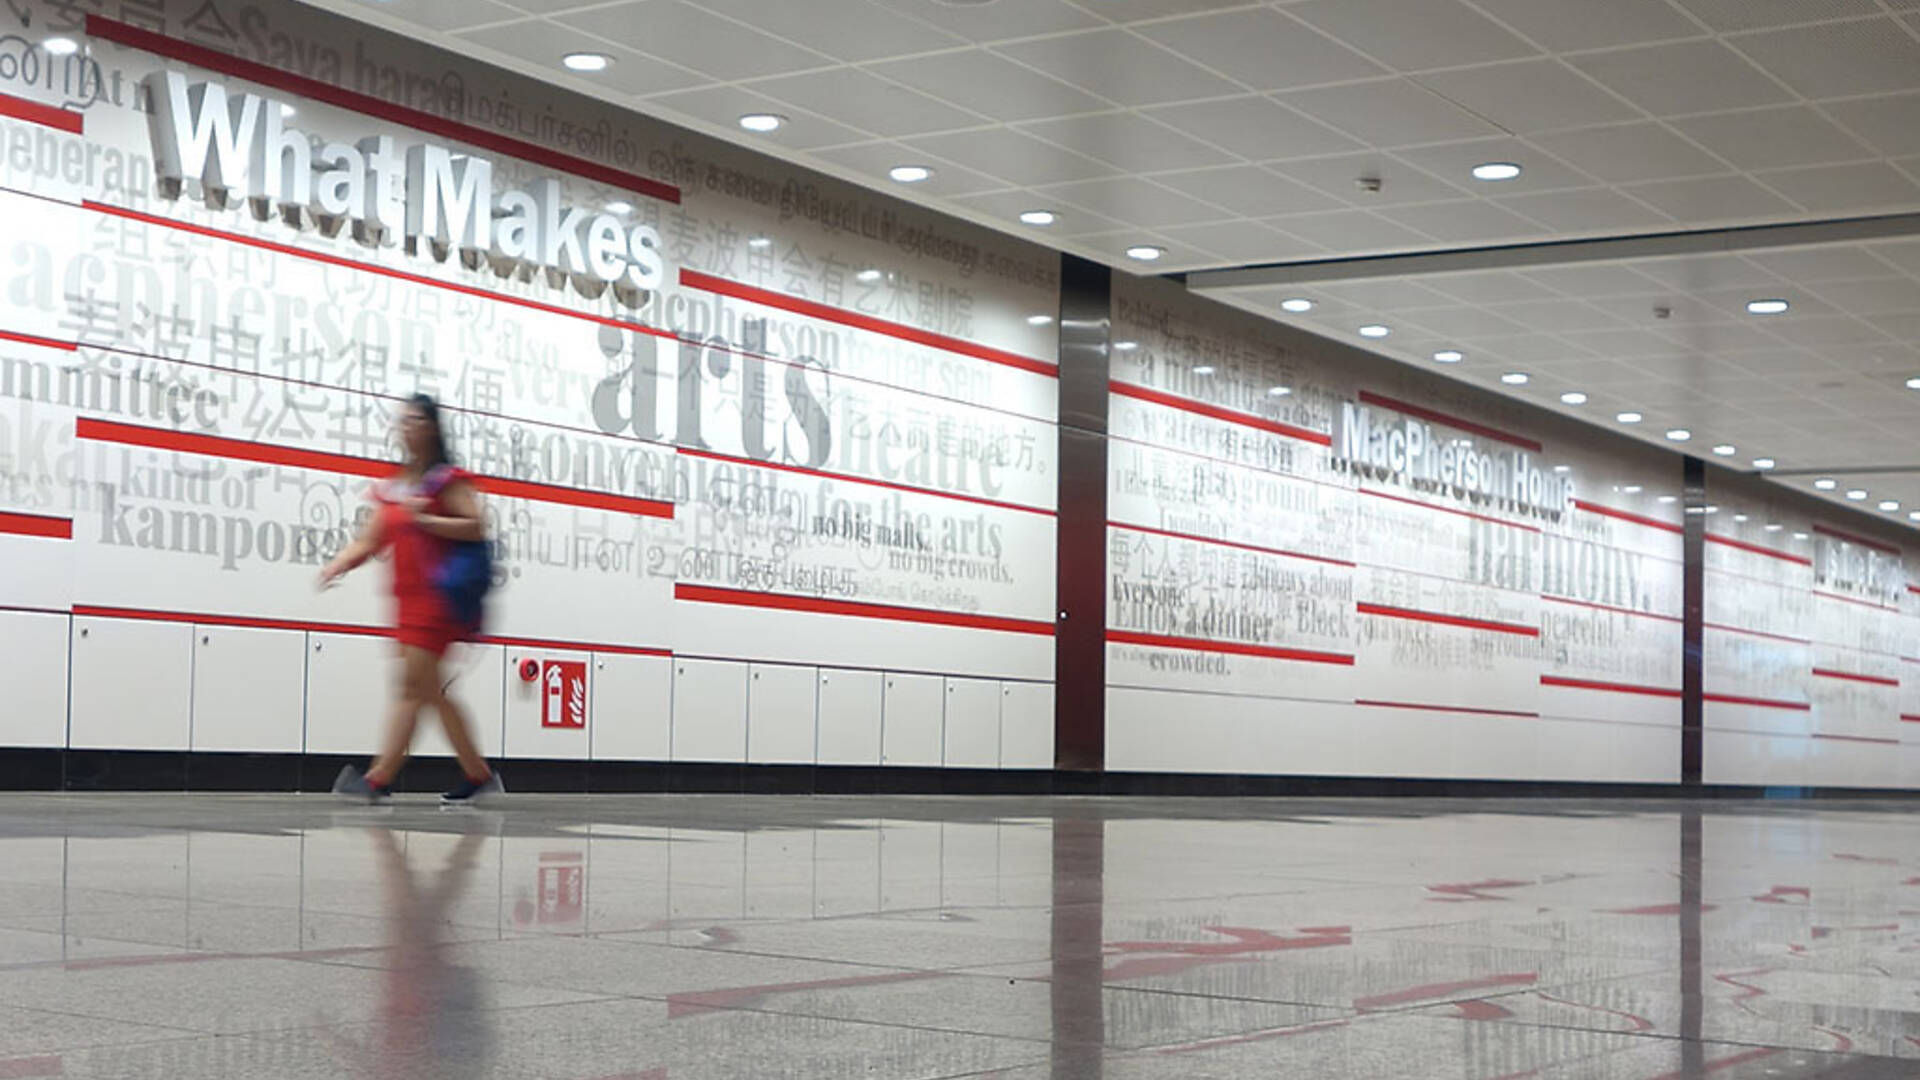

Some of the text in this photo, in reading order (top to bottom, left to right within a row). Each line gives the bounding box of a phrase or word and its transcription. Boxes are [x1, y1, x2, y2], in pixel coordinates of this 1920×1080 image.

[150, 70, 406, 243] What
[424, 142, 663, 284] Makes
[590, 315, 833, 470] arts
[1342, 402, 1576, 513] MacPherson Home
[812, 512, 838, 538] no
[842, 508, 872, 548] big
[941, 512, 1003, 560] arts
[889, 547, 913, 572] no
[916, 551, 944, 581] big
[1150, 650, 1232, 677] crowded.
